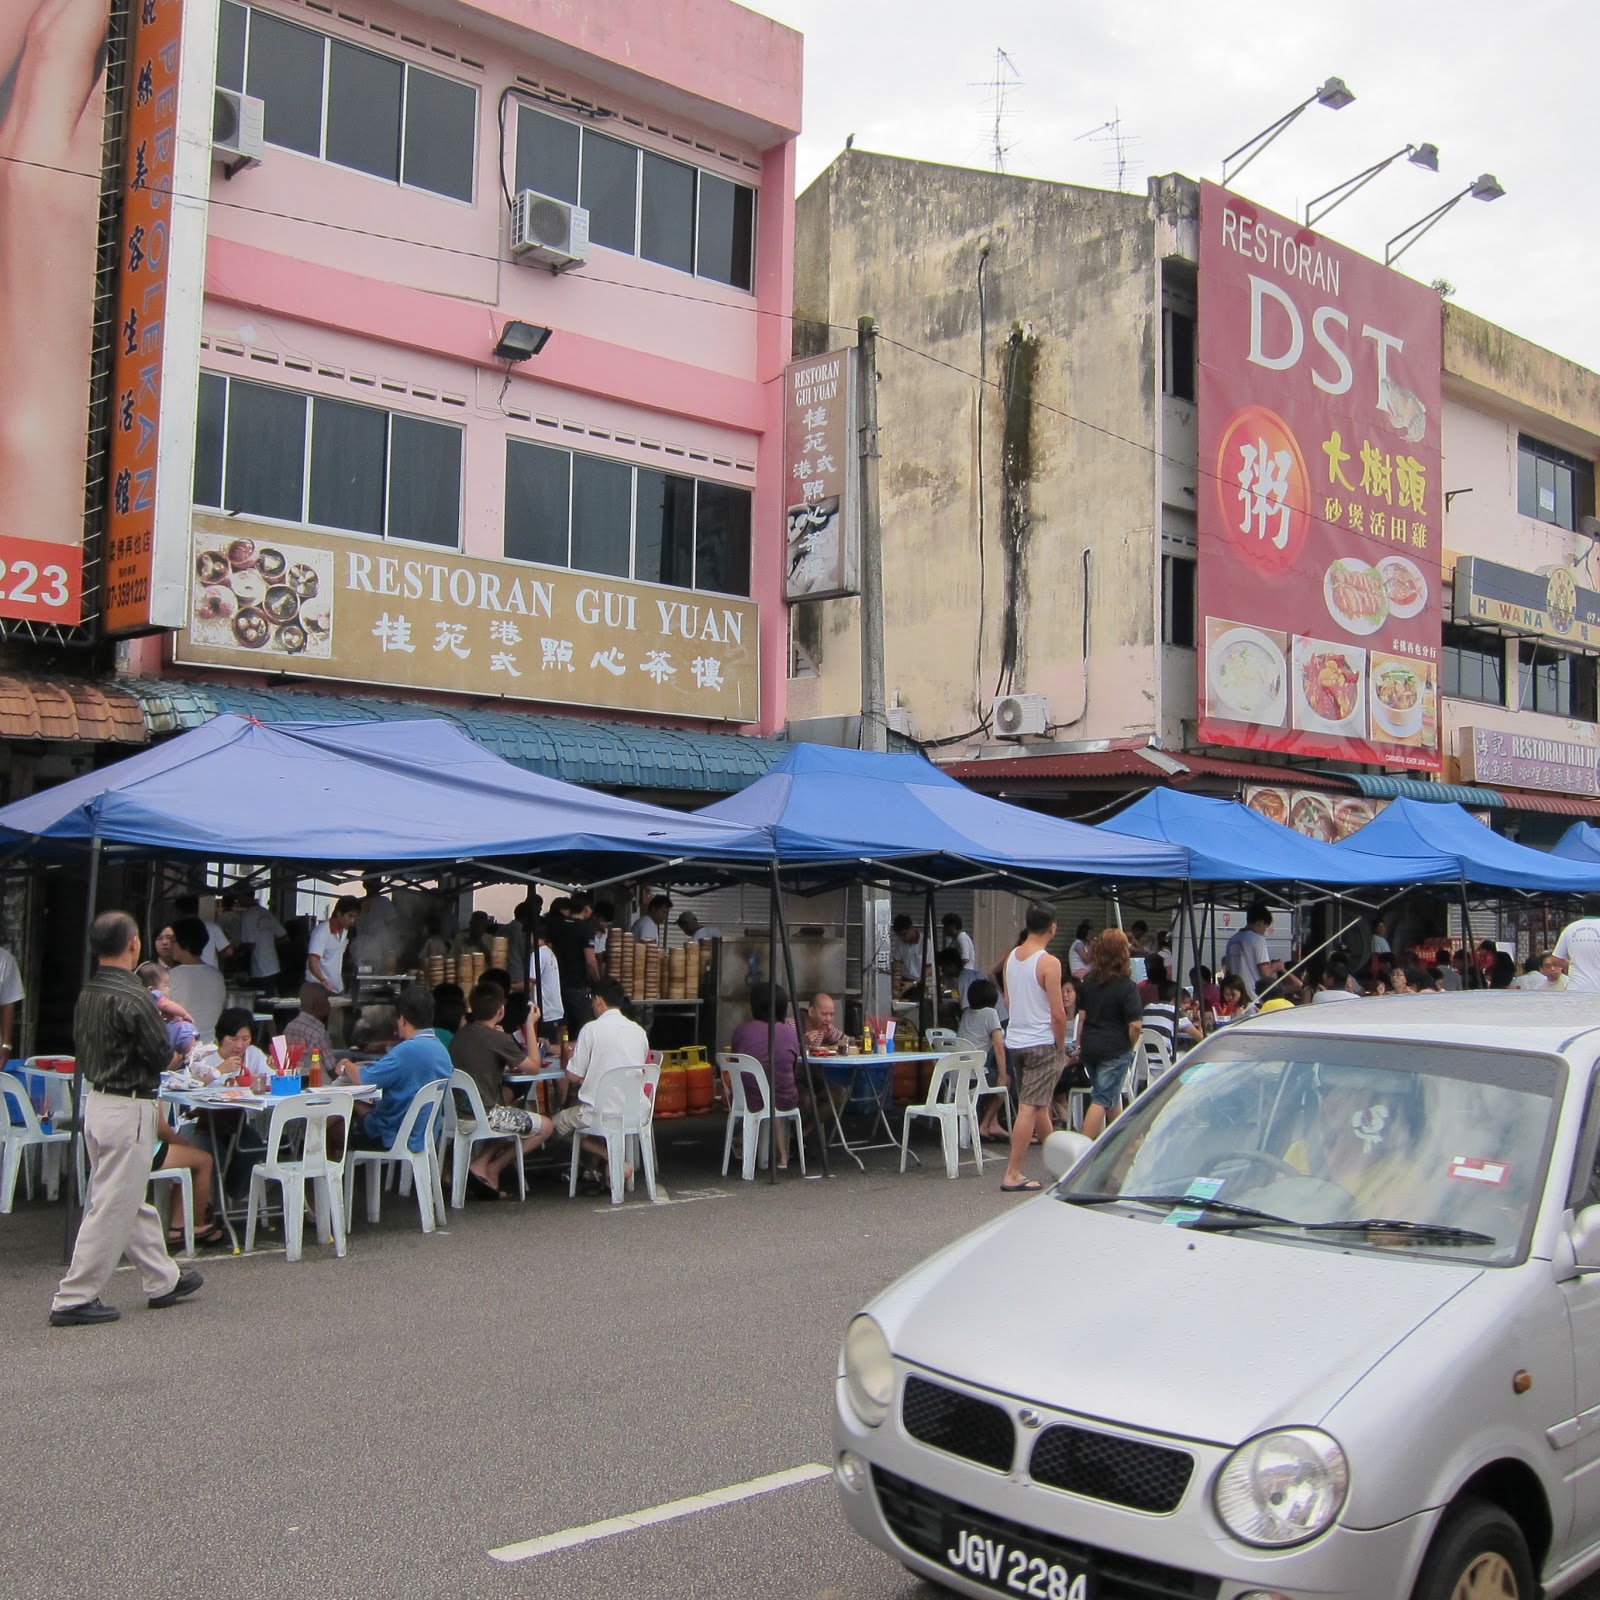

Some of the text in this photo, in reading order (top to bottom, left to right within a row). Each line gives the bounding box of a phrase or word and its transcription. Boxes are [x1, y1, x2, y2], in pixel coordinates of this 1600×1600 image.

[1222, 207, 1340, 297] RESTORAN
[794, 360, 840, 389] RESTORAN
[1246, 273, 1404, 413] DST
[796, 381, 838, 407] GUI YUAN
[1237, 437, 1293, 550] 粥
[1322, 430, 1428, 516] 大樹頭
[0, 558, 69, 608] 23
[346, 551, 743, 645] RESTORAN GUI YUAN
[1512, 736, 1566, 764] RESTORAN
[1567, 744, 1585, 767] HAI
[947, 1530, 1087, 1600] JGV 2284
